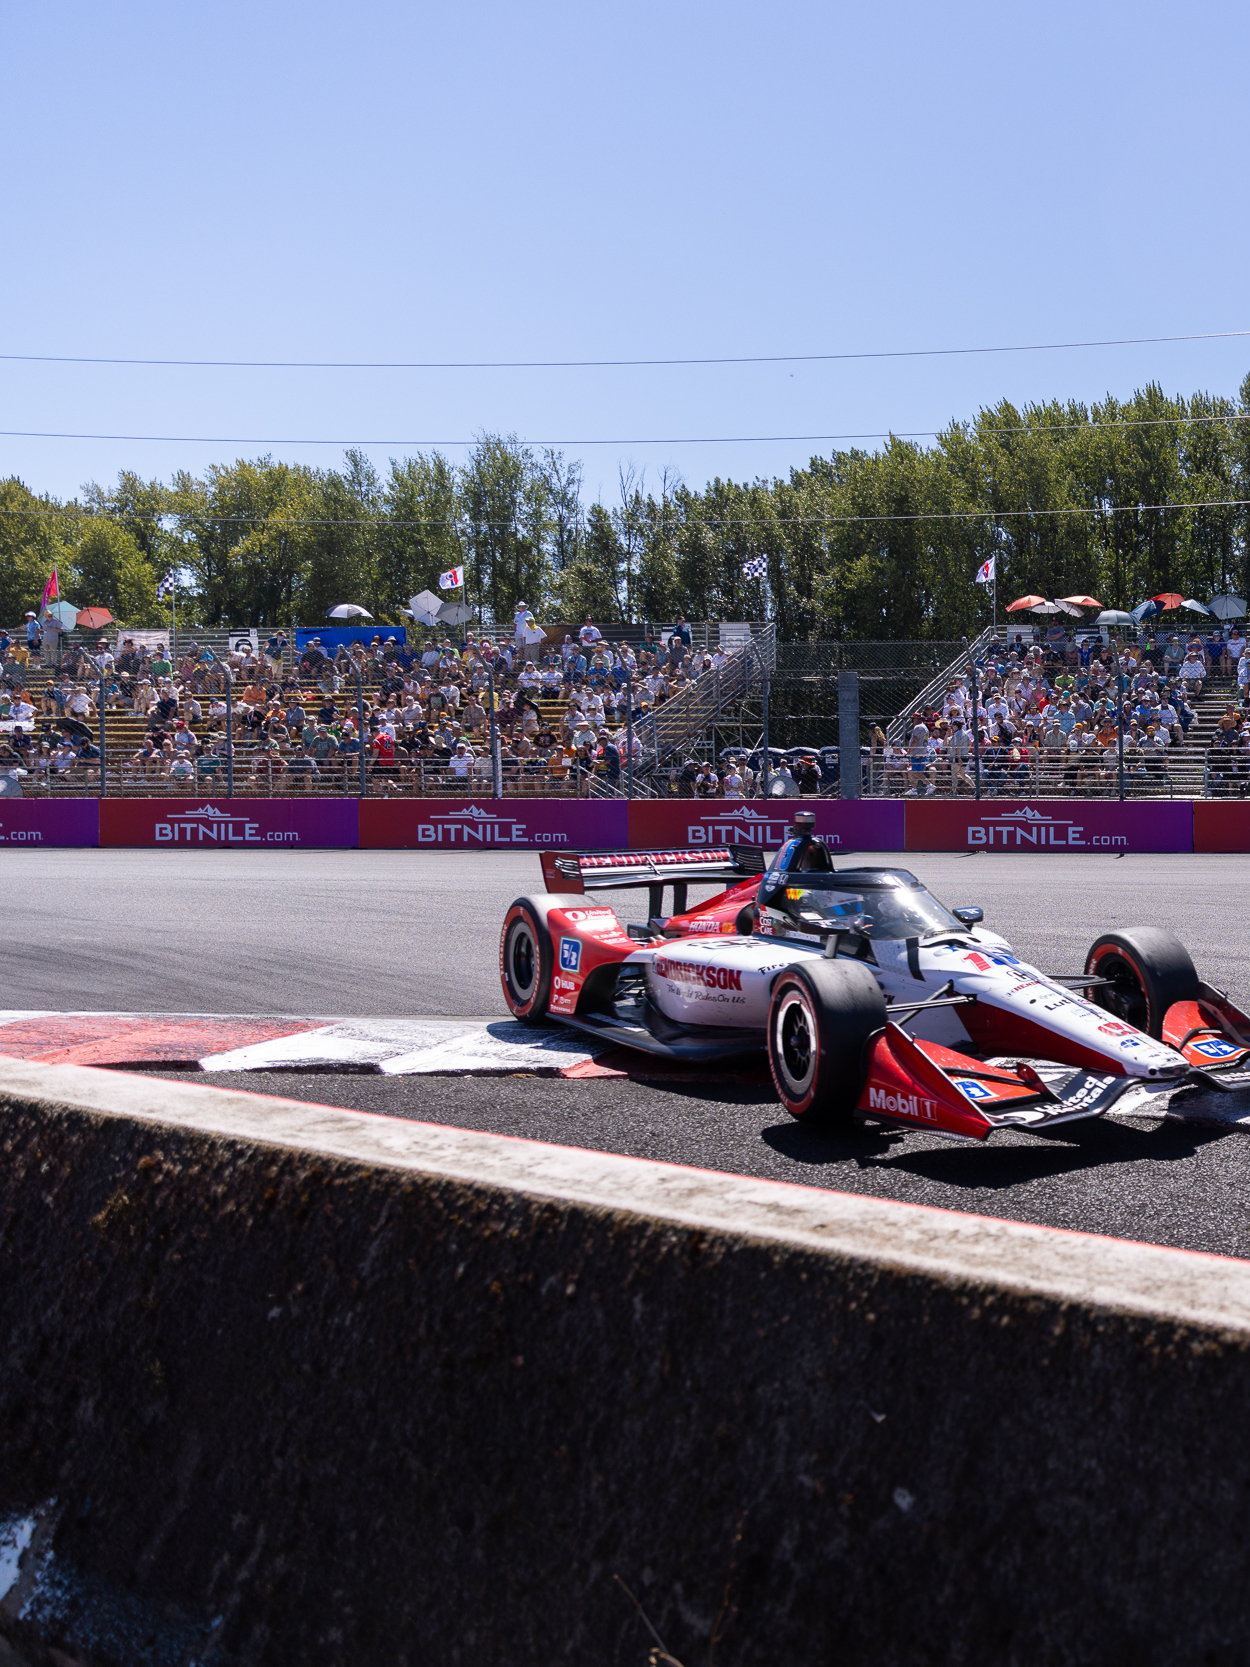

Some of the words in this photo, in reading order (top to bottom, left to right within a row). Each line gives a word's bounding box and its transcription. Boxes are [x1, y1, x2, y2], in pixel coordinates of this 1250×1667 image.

[155, 823, 299, 841] BITNILE.com
[417, 824, 567, 843] BITNILE.com
[967, 826, 1127, 845] BITNILE.com
[579, 849, 730, 867] HENDRICKSON
[688, 921, 721, 934] HONDA
[656, 953, 743, 991] HENDRICKSON
[561, 980, 575, 991] HUB
[869, 1087, 919, 1117] Mobil
